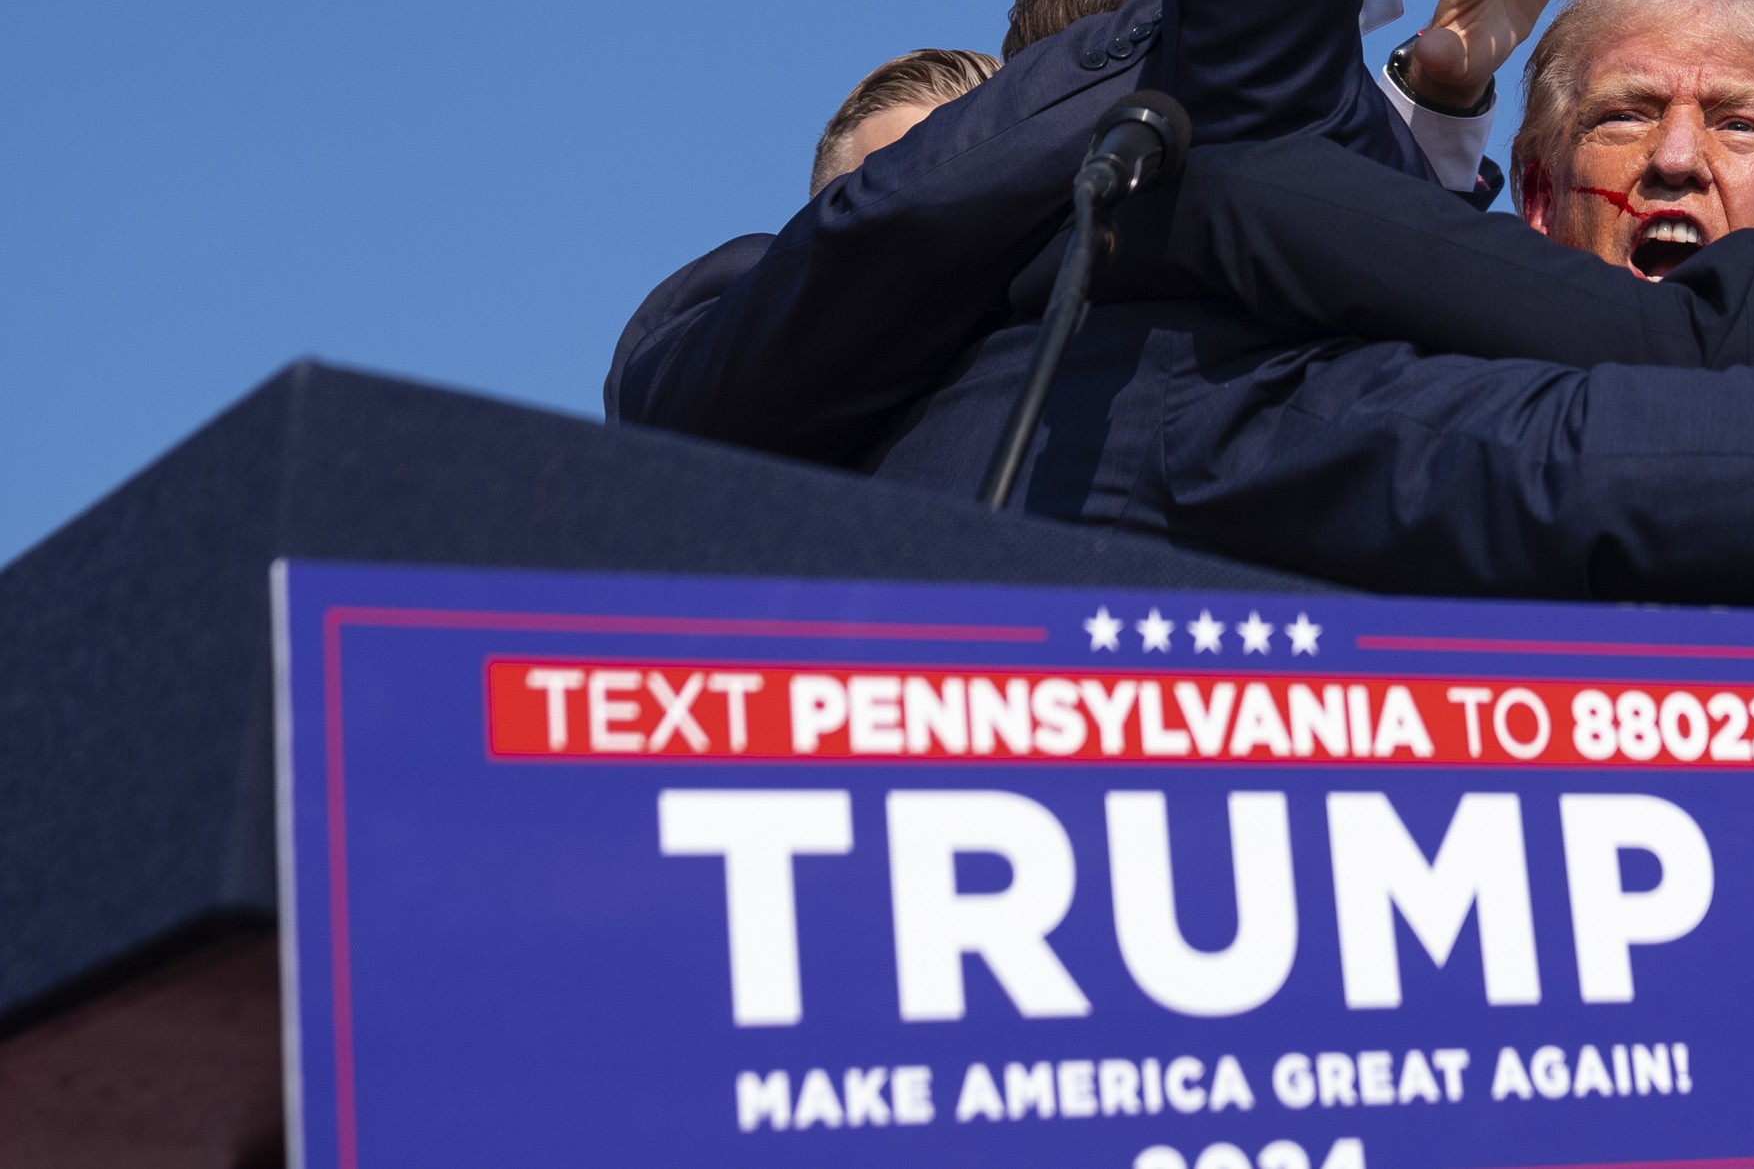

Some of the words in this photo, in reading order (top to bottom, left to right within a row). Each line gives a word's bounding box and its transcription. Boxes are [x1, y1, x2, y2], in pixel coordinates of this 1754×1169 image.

[526, 668, 763, 752] TEXT
[789, 674, 1435, 758] PENNSYLVANIA
[1446, 686, 1552, 760] TO
[657, 788, 1716, 1027] TRUMP
[735, 1065, 935, 1132] MAKE
[956, 1054, 1255, 1122] AMERICA
[1271, 1048, 1470, 1109] GREAT
[1491, 1042, 1694, 1101] AGAIN!
